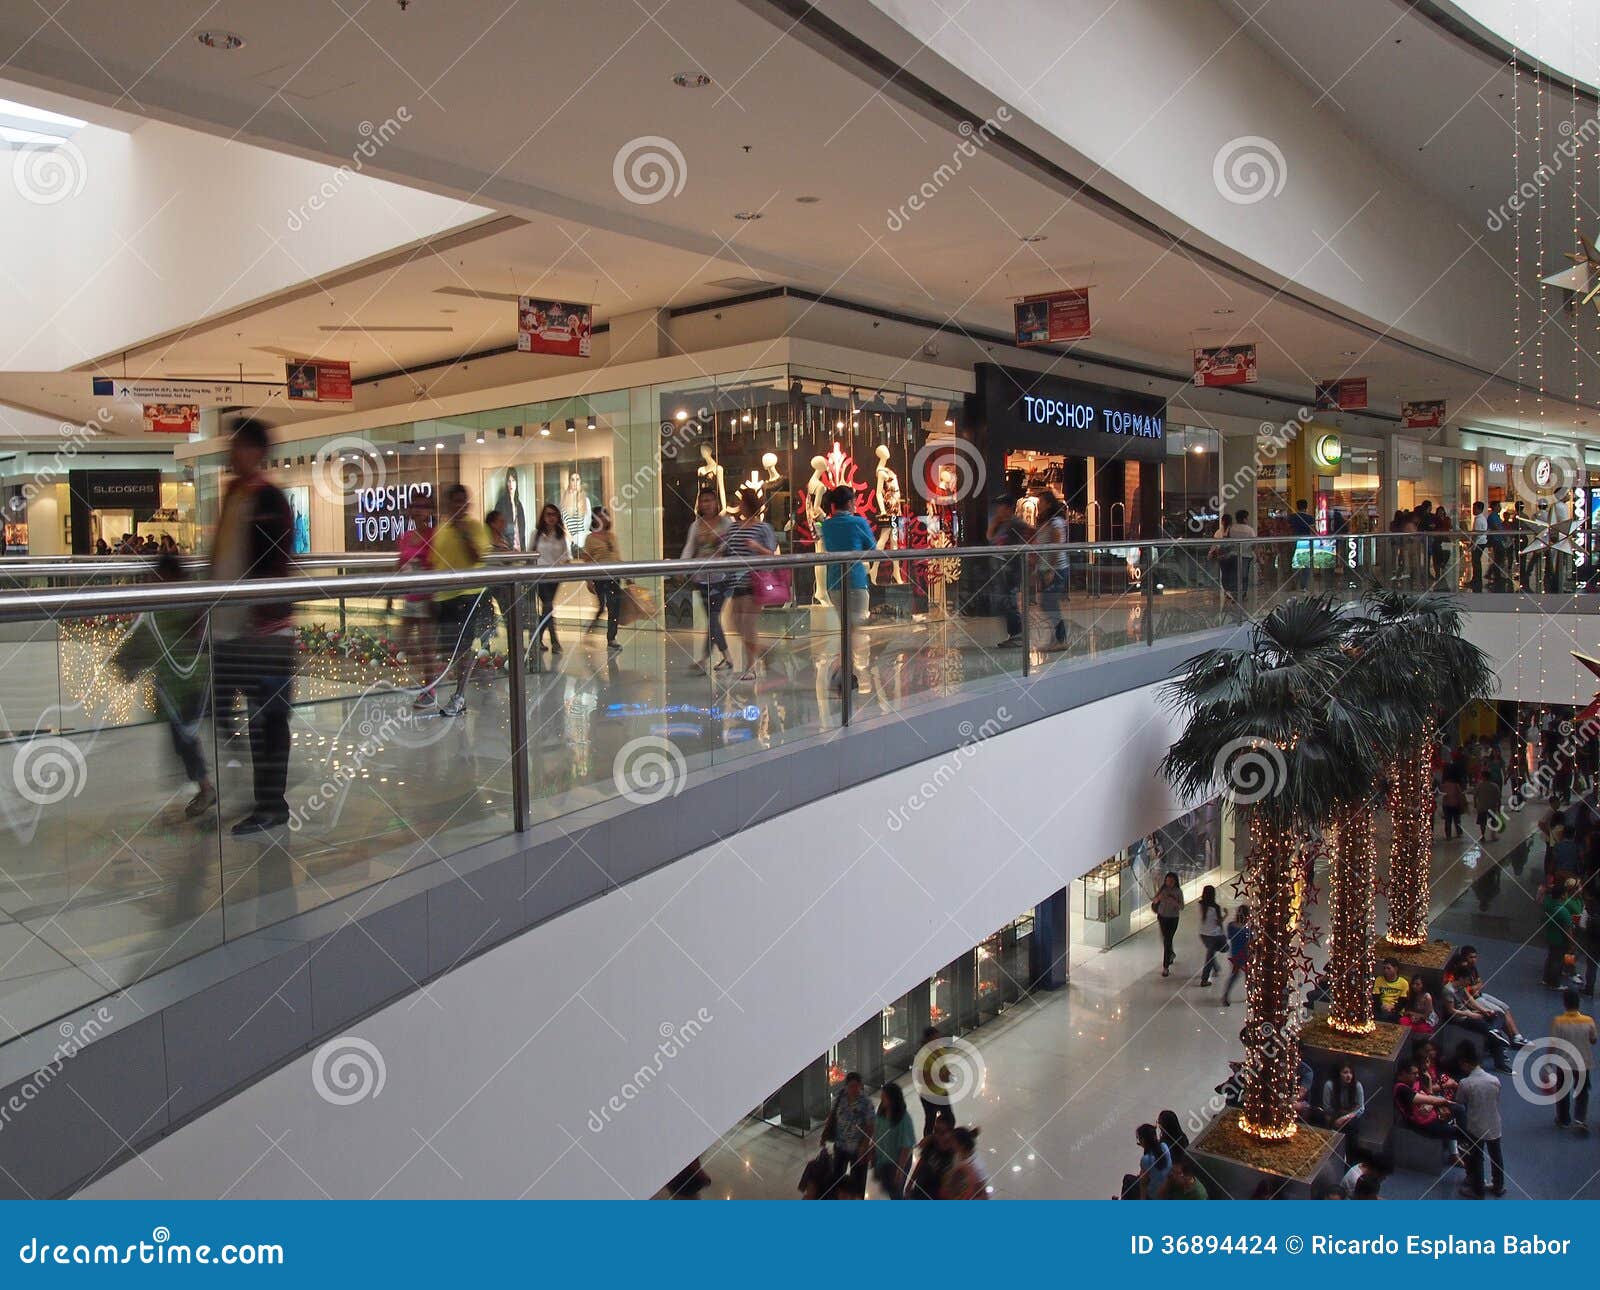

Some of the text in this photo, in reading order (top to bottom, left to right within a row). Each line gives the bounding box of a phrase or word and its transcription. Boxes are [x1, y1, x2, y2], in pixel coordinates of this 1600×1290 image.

[1024, 396, 1162, 439] TOPSHOP TOPMAN
[93, 484, 155, 494] SLEDGERS
[355, 513, 433, 542] TOPMA
